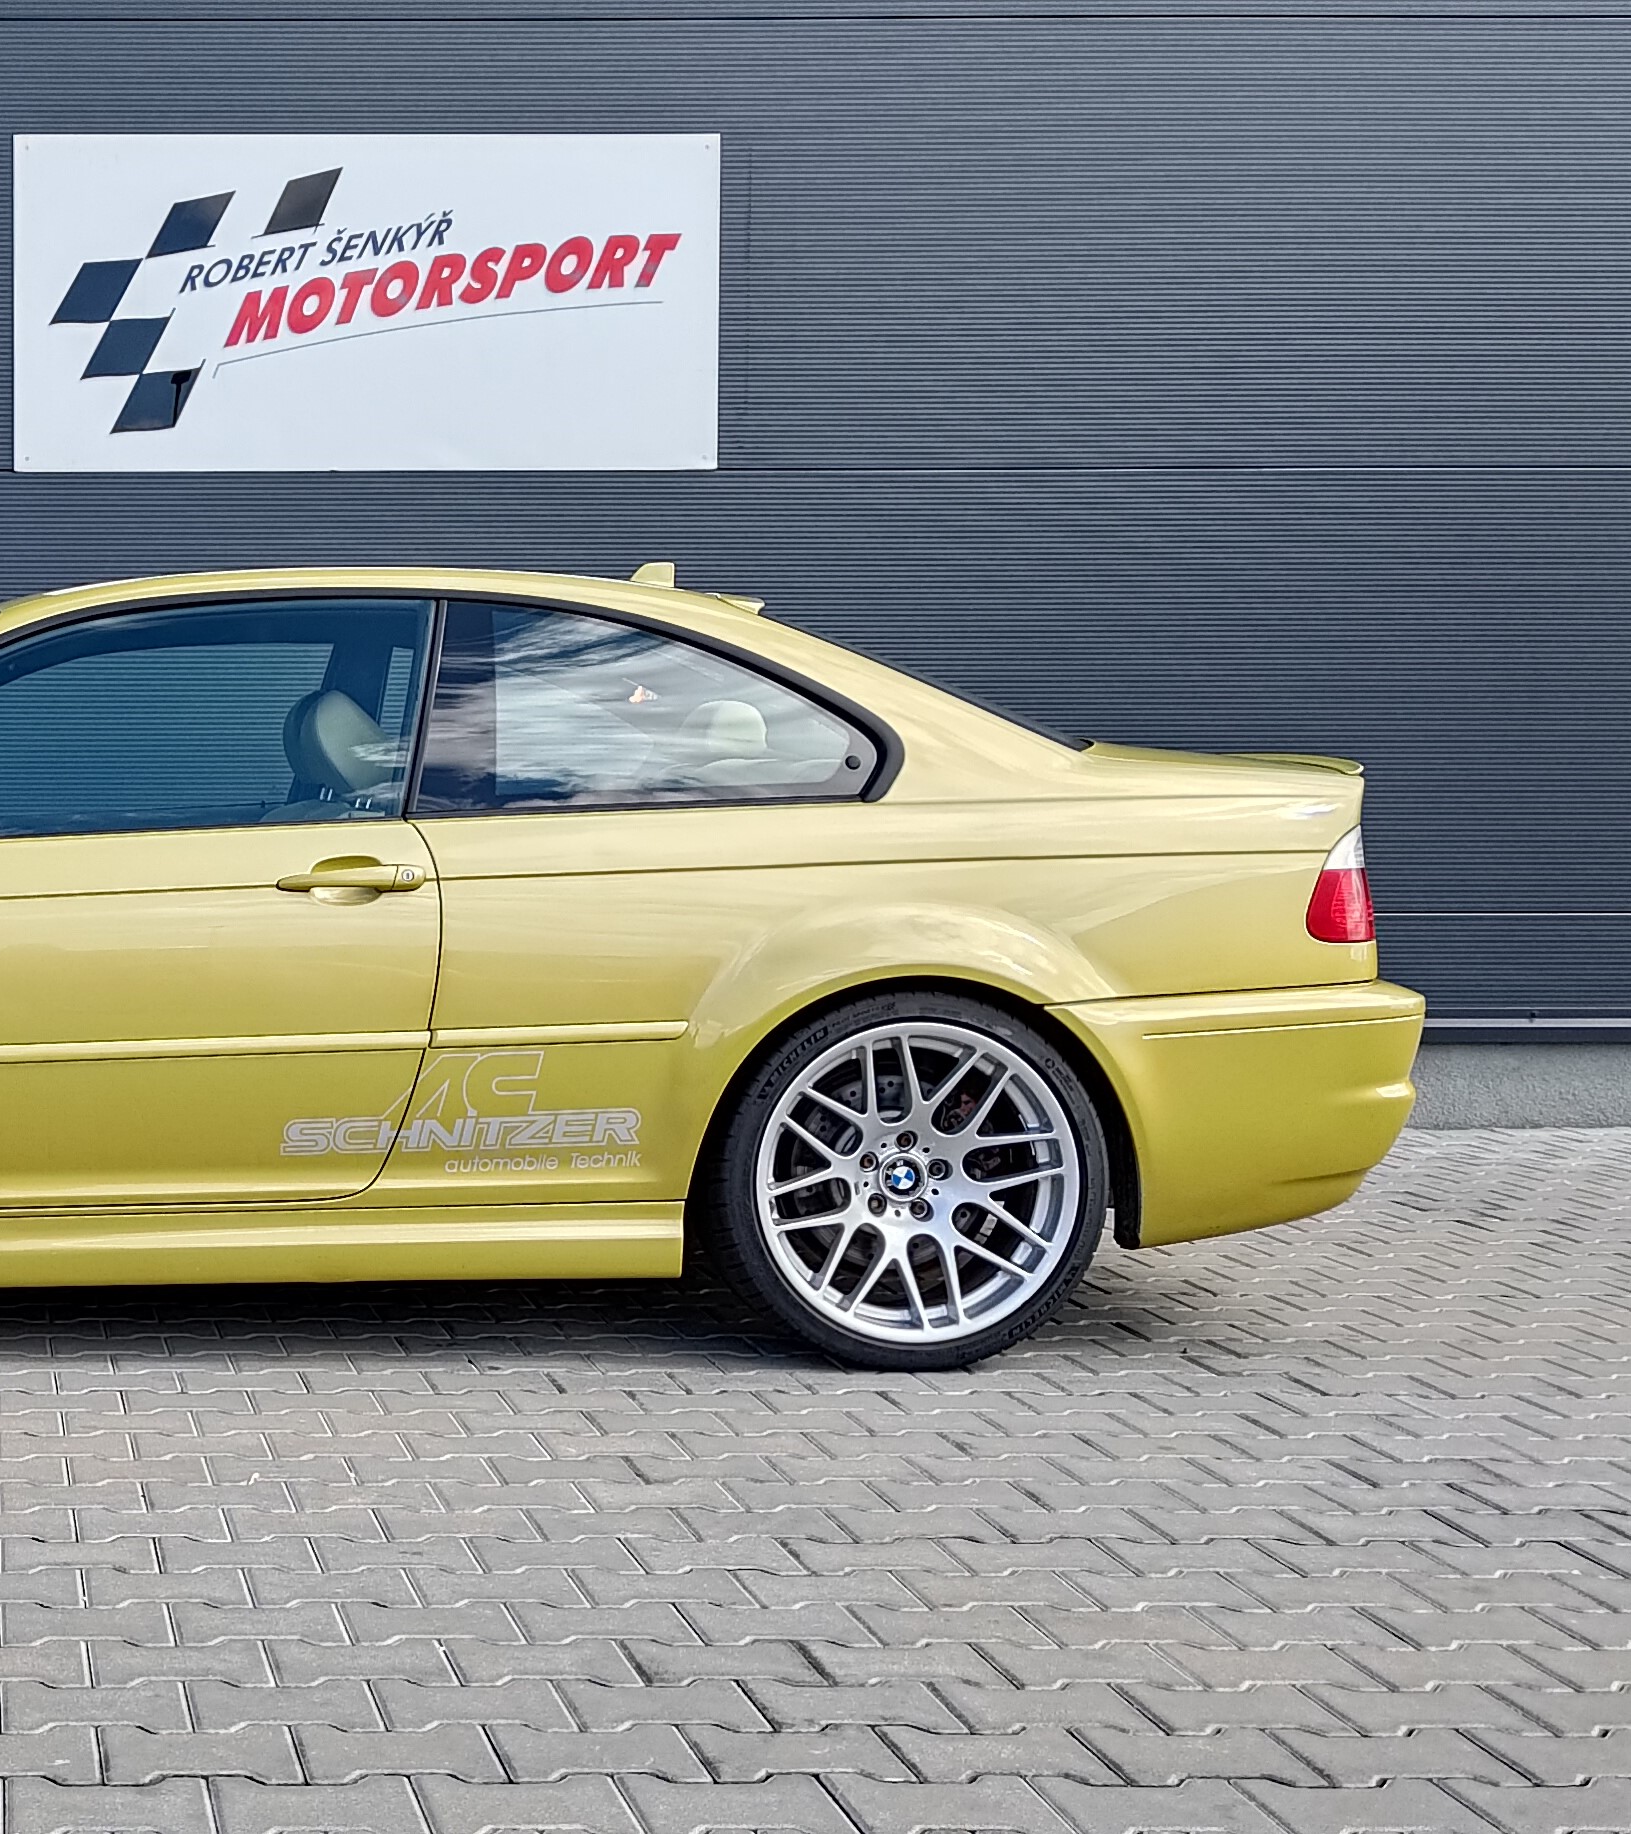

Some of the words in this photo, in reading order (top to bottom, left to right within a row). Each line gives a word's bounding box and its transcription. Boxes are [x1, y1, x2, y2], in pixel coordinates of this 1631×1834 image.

[180, 242, 317, 293] ROBERT
[320, 209, 454, 267] ŠENKÝŘ
[224, 233, 682, 348] MOTORSPORT
[280, 1107, 641, 1155] SCHNITZER
[445, 1152, 558, 1173] automobile
[570, 1150, 642, 1168] Technik
